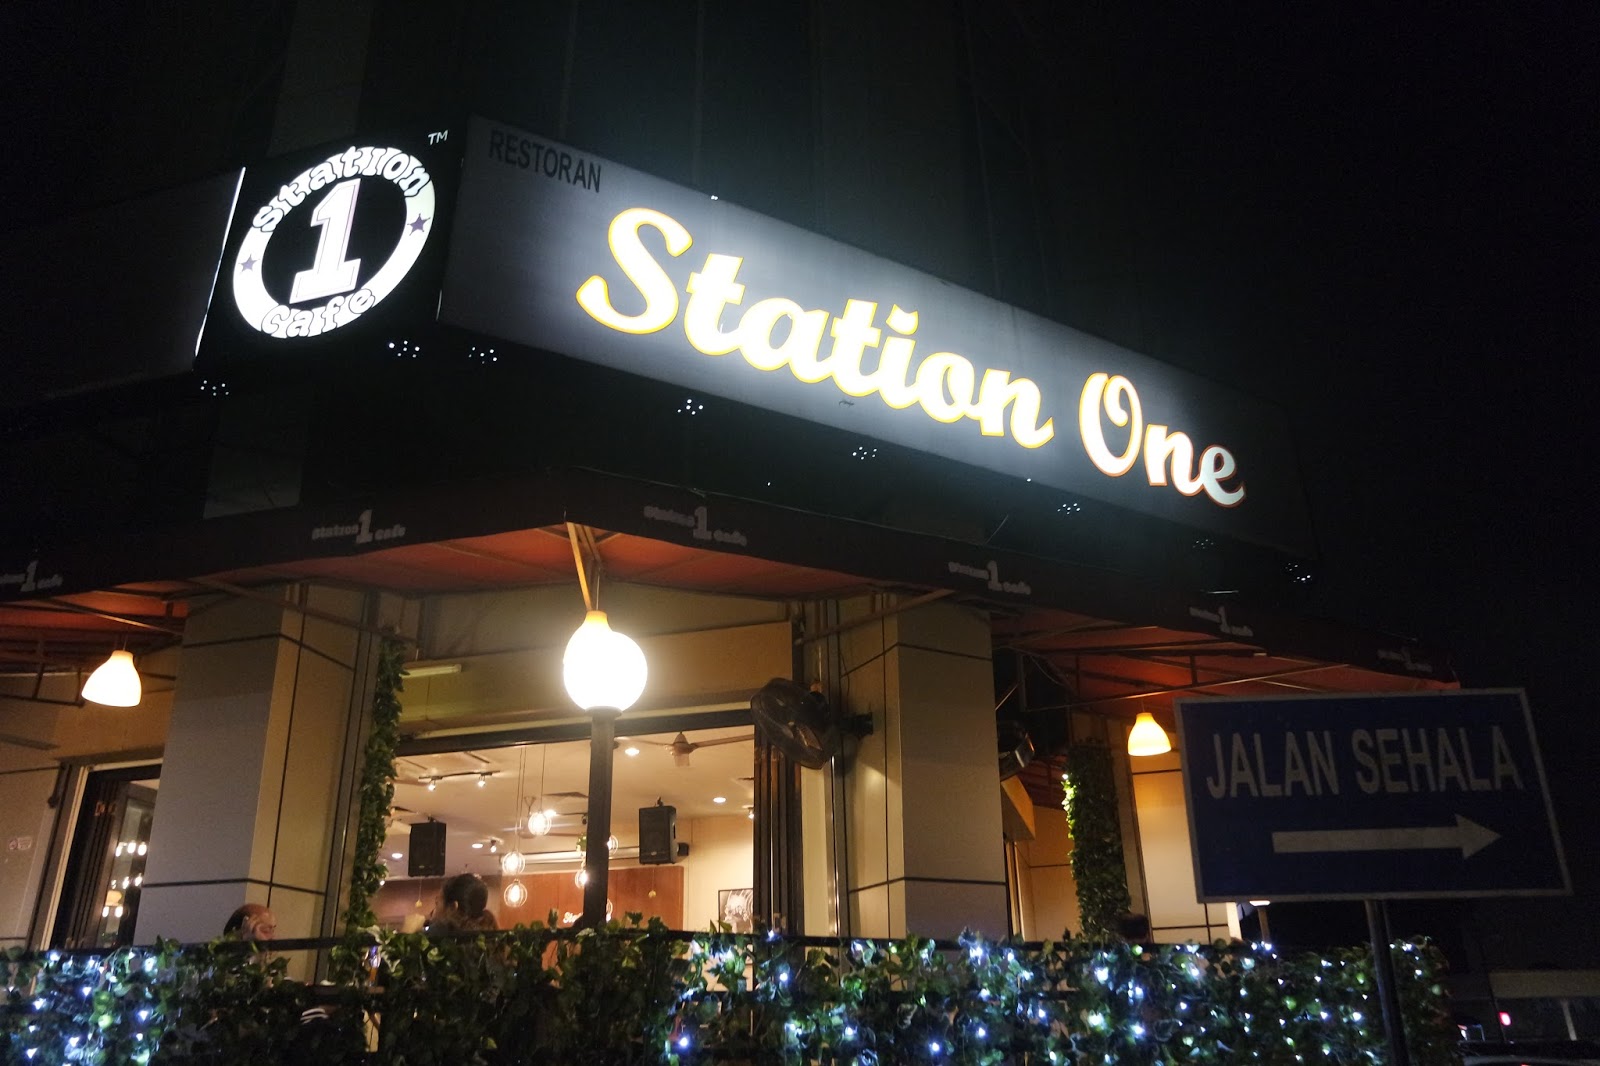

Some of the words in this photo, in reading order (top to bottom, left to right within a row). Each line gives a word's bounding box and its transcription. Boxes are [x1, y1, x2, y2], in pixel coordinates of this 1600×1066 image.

[427, 129, 449, 146] TM
[488, 128, 602, 194] RESTORAN
[289, 178, 362, 305] 1
[576, 207, 1055, 449] Station
[1078, 372, 1246, 508] One
[355, 508, 374, 544] 1
[1205, 730, 1341, 800] JALAN
[1351, 724, 1525, 795] SEHALA
